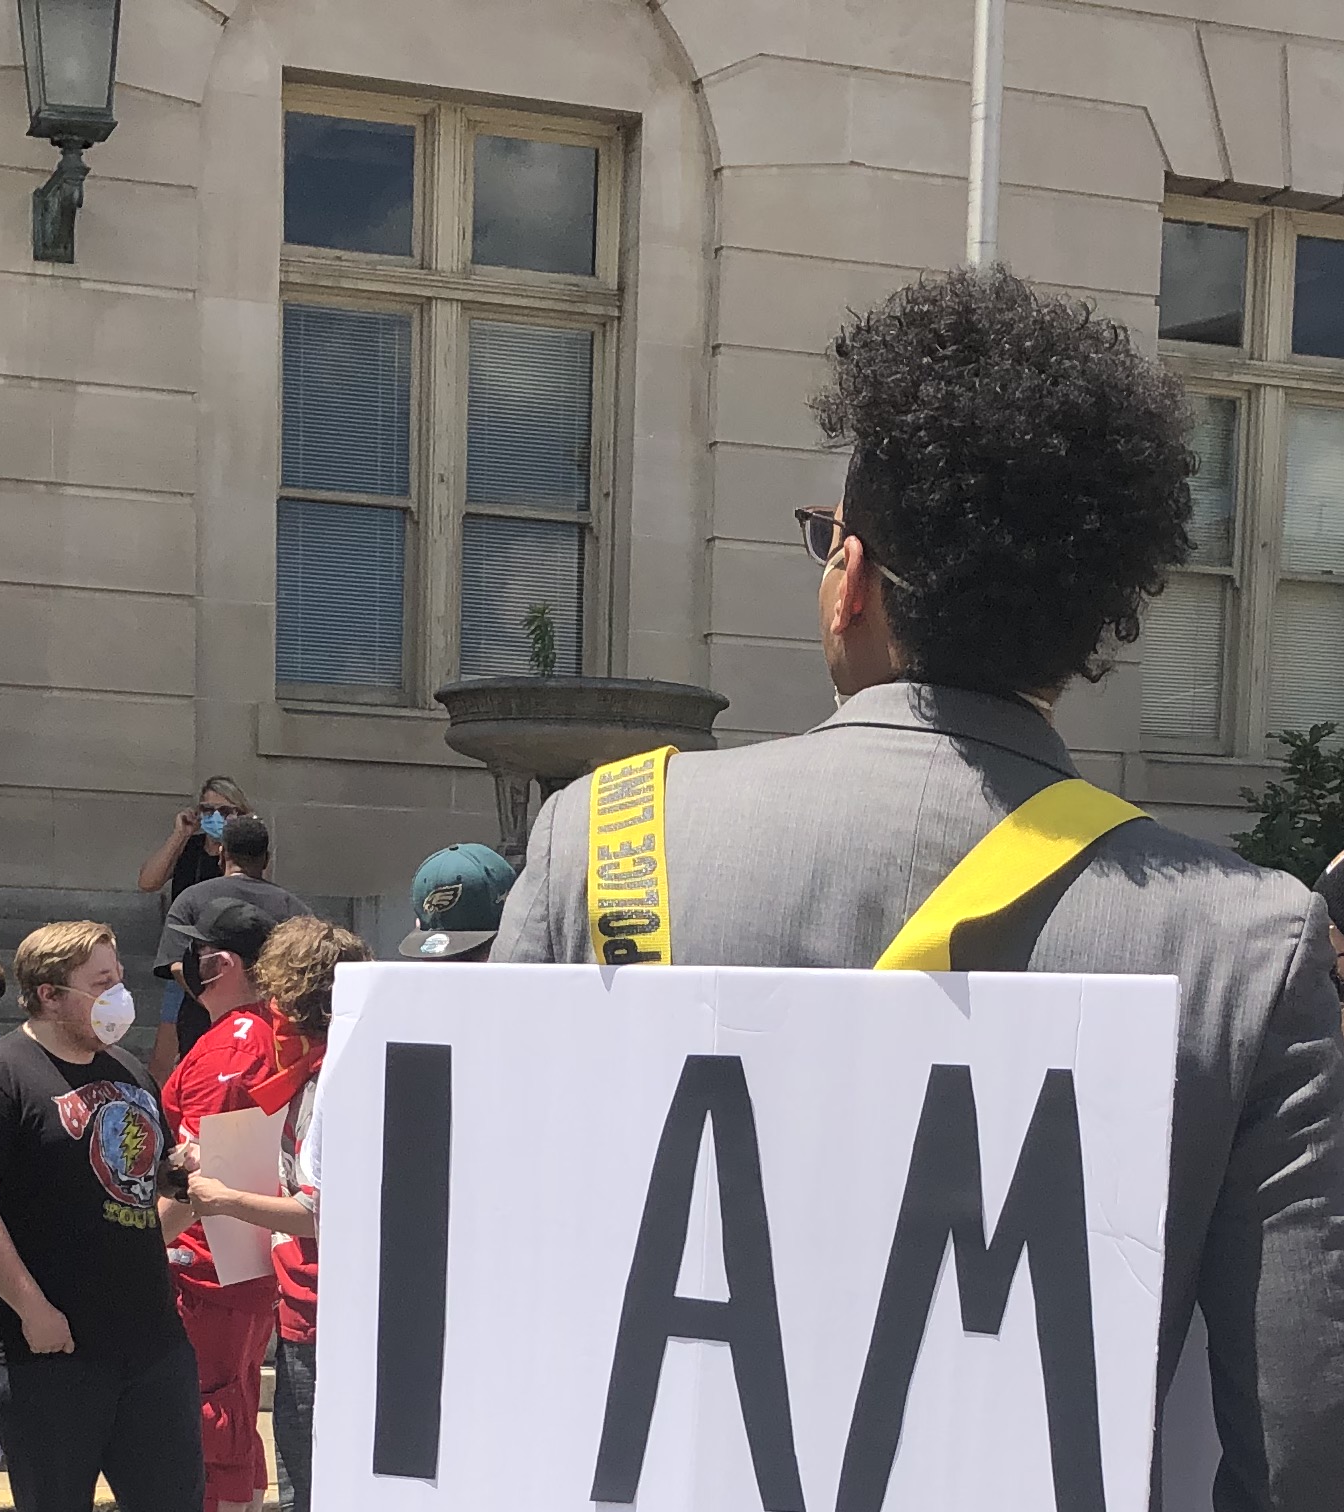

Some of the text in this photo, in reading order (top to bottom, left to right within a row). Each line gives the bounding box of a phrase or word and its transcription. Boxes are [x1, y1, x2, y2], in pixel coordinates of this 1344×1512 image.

[597, 758, 662, 965] POLICE LINE
[233, 1017, 254, 1039] 7
[373, 1042, 453, 1480] I
